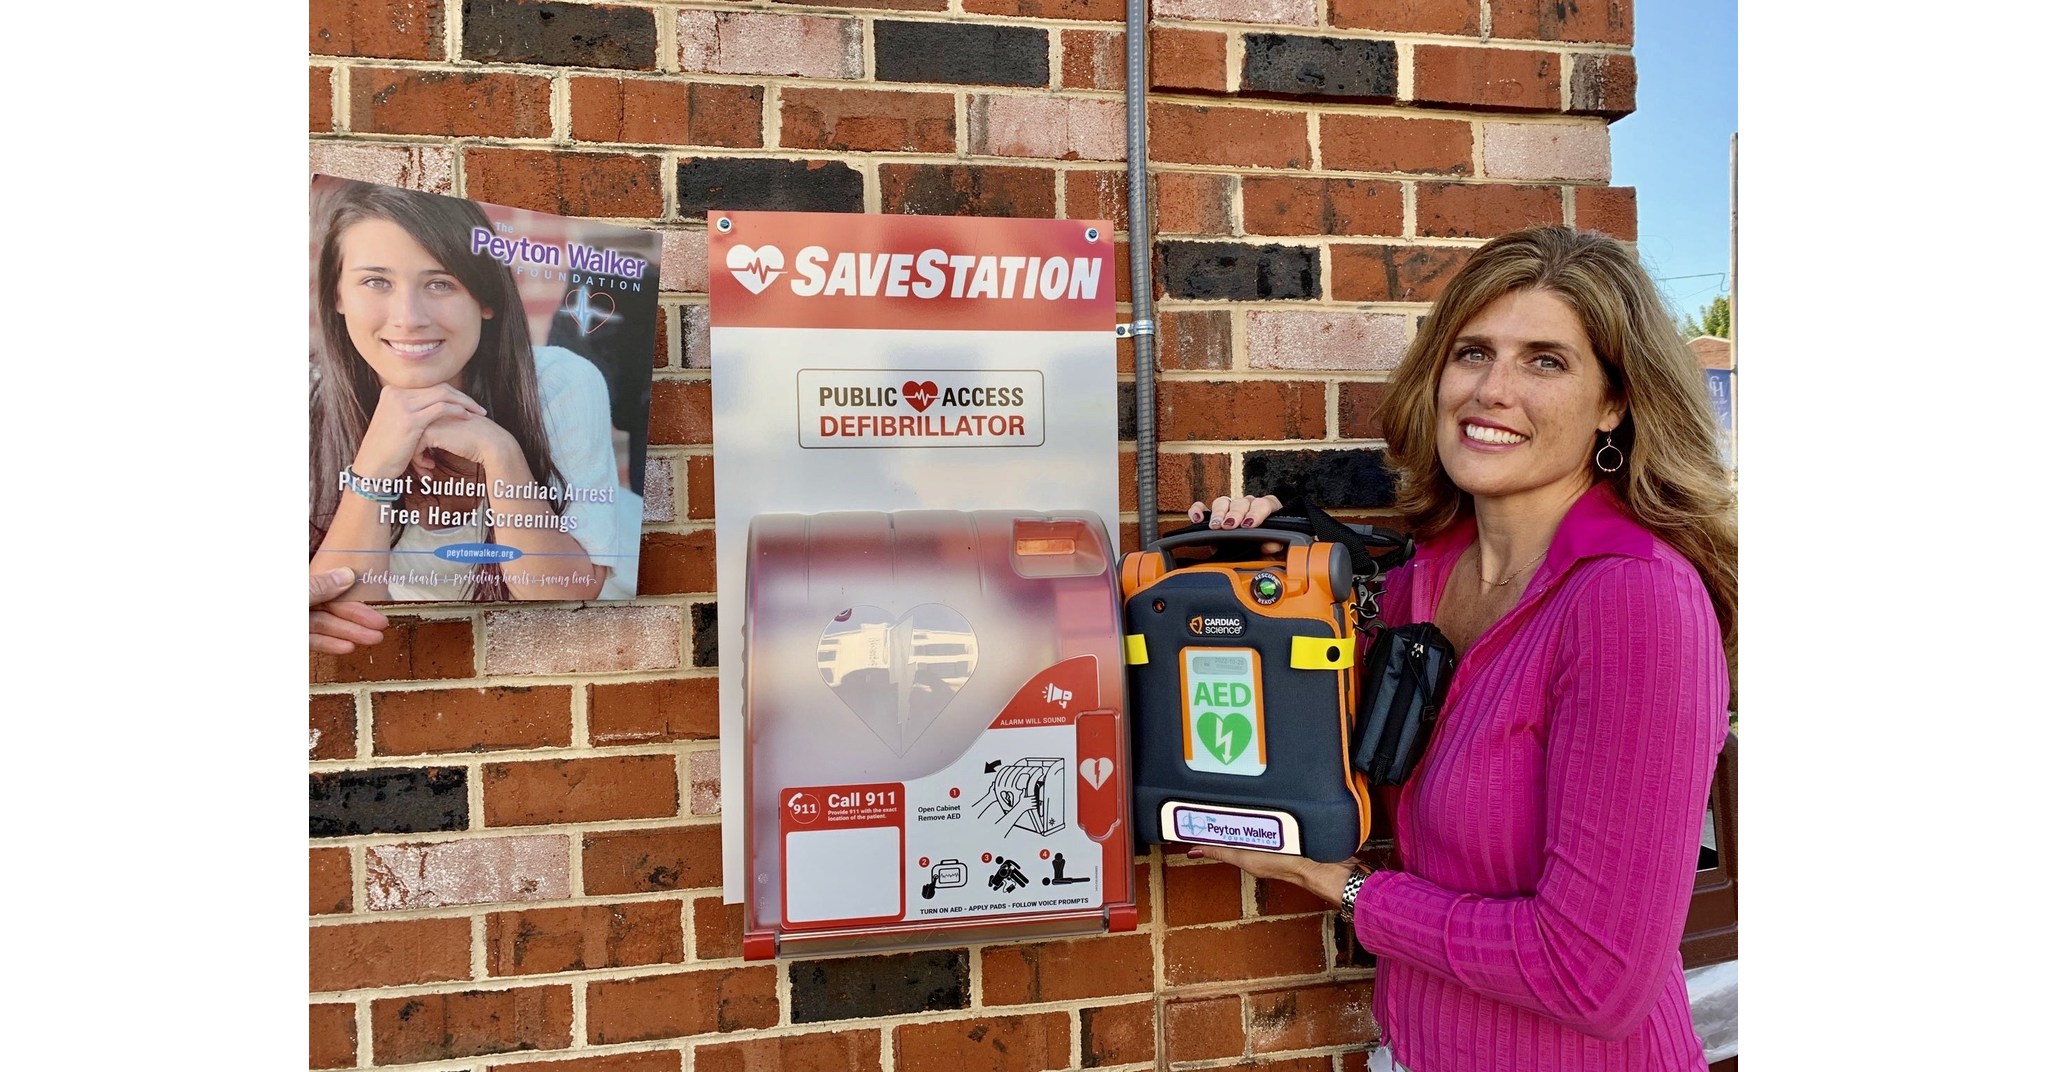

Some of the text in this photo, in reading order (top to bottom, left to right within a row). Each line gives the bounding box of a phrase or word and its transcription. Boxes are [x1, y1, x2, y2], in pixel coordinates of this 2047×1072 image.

[495, 221, 515, 234] The
[472, 228, 646, 278] Peyton Walker
[516, 266, 642, 293] FOUNDATION
[819, 386, 1024, 408] PUBLIC ACCESS
[819, 415, 1025, 438] DEFIBRILLATOR
[338, 471, 615, 504] Prevent Sudden Cardiac Arrest
[380, 504, 578, 533] Free Heart Screenings
[446, 548, 515, 559] peytonwalker.org
[362, 568, 406, 587] checking
[408, 568, 438, 586] hearts
[453, 569, 500, 587] protecting
[502, 571, 530, 585] hearts
[539, 573, 570, 588] saving
[1204, 618, 1240, 626] CARDIAC
[1193, 681, 1252, 708] AED
[793, 803, 817, 815] 911
[828, 791, 895, 808] Call 911
[1207, 823, 1277, 839] Peyton Walker
[1223, 835, 1277, 845] FOUNDATION
